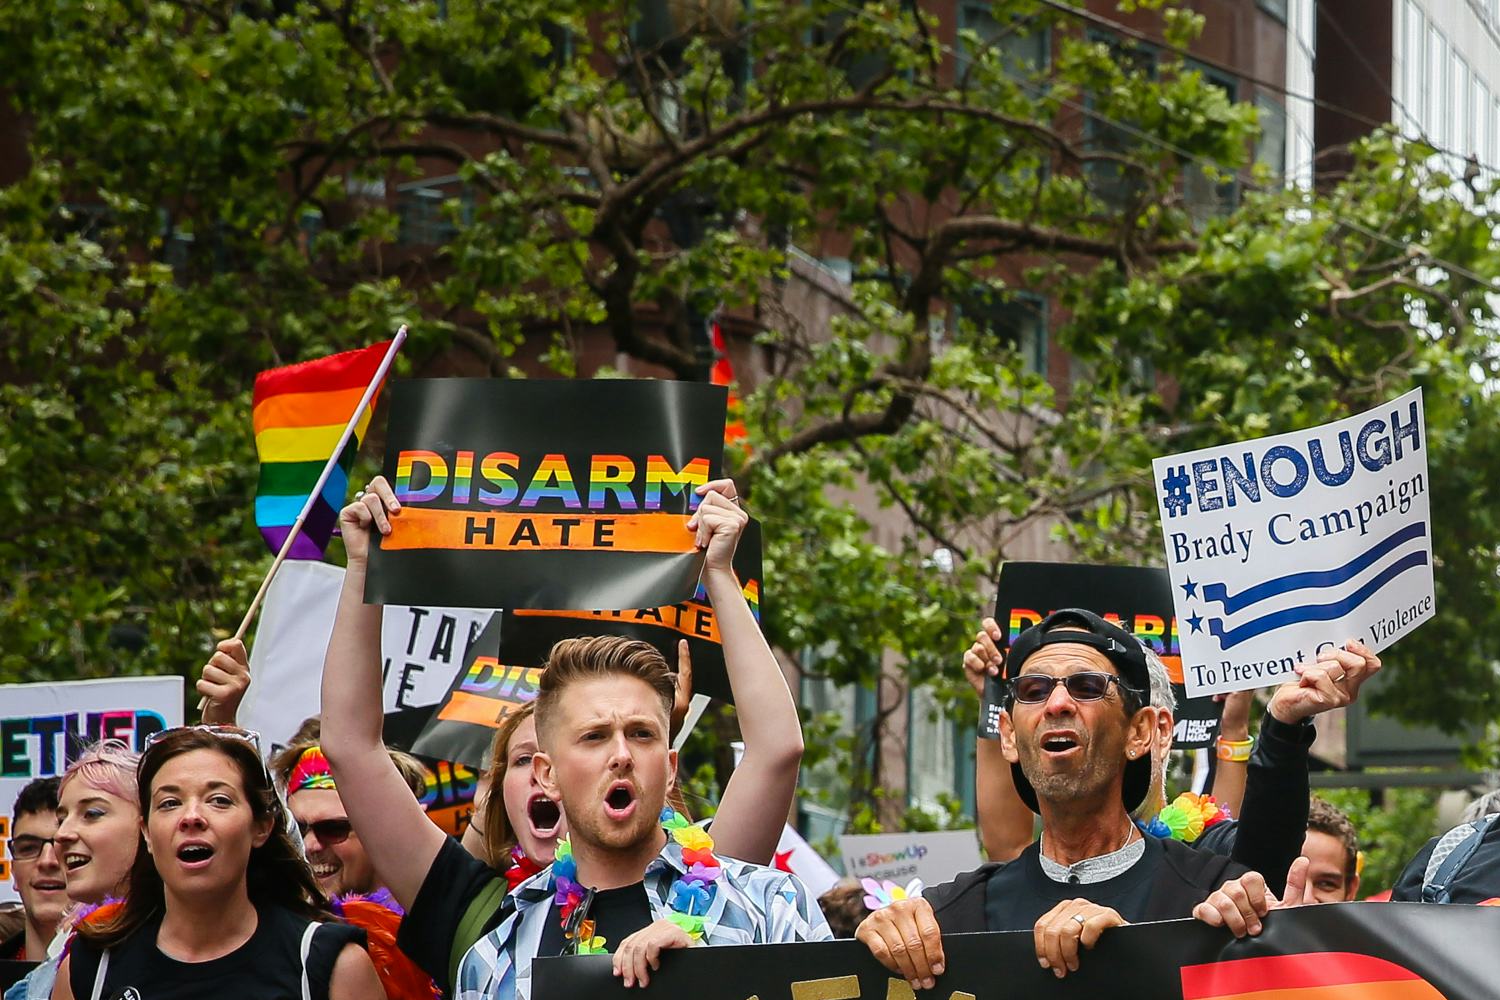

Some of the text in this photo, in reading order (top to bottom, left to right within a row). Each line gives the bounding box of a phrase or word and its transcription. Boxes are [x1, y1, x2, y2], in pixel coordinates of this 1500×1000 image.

[394, 450, 711, 511] DISARM
[1162, 401, 1421, 518] #ENOUGH
[464, 516, 618, 547] HATE
[1171, 473, 1425, 563] Brady Campaign
[593, 603, 713, 638] ATE
[1191, 665, 1216, 687] To
[1222, 650, 1305, 684] Prevent
[1369, 595, 1432, 645] Violence
